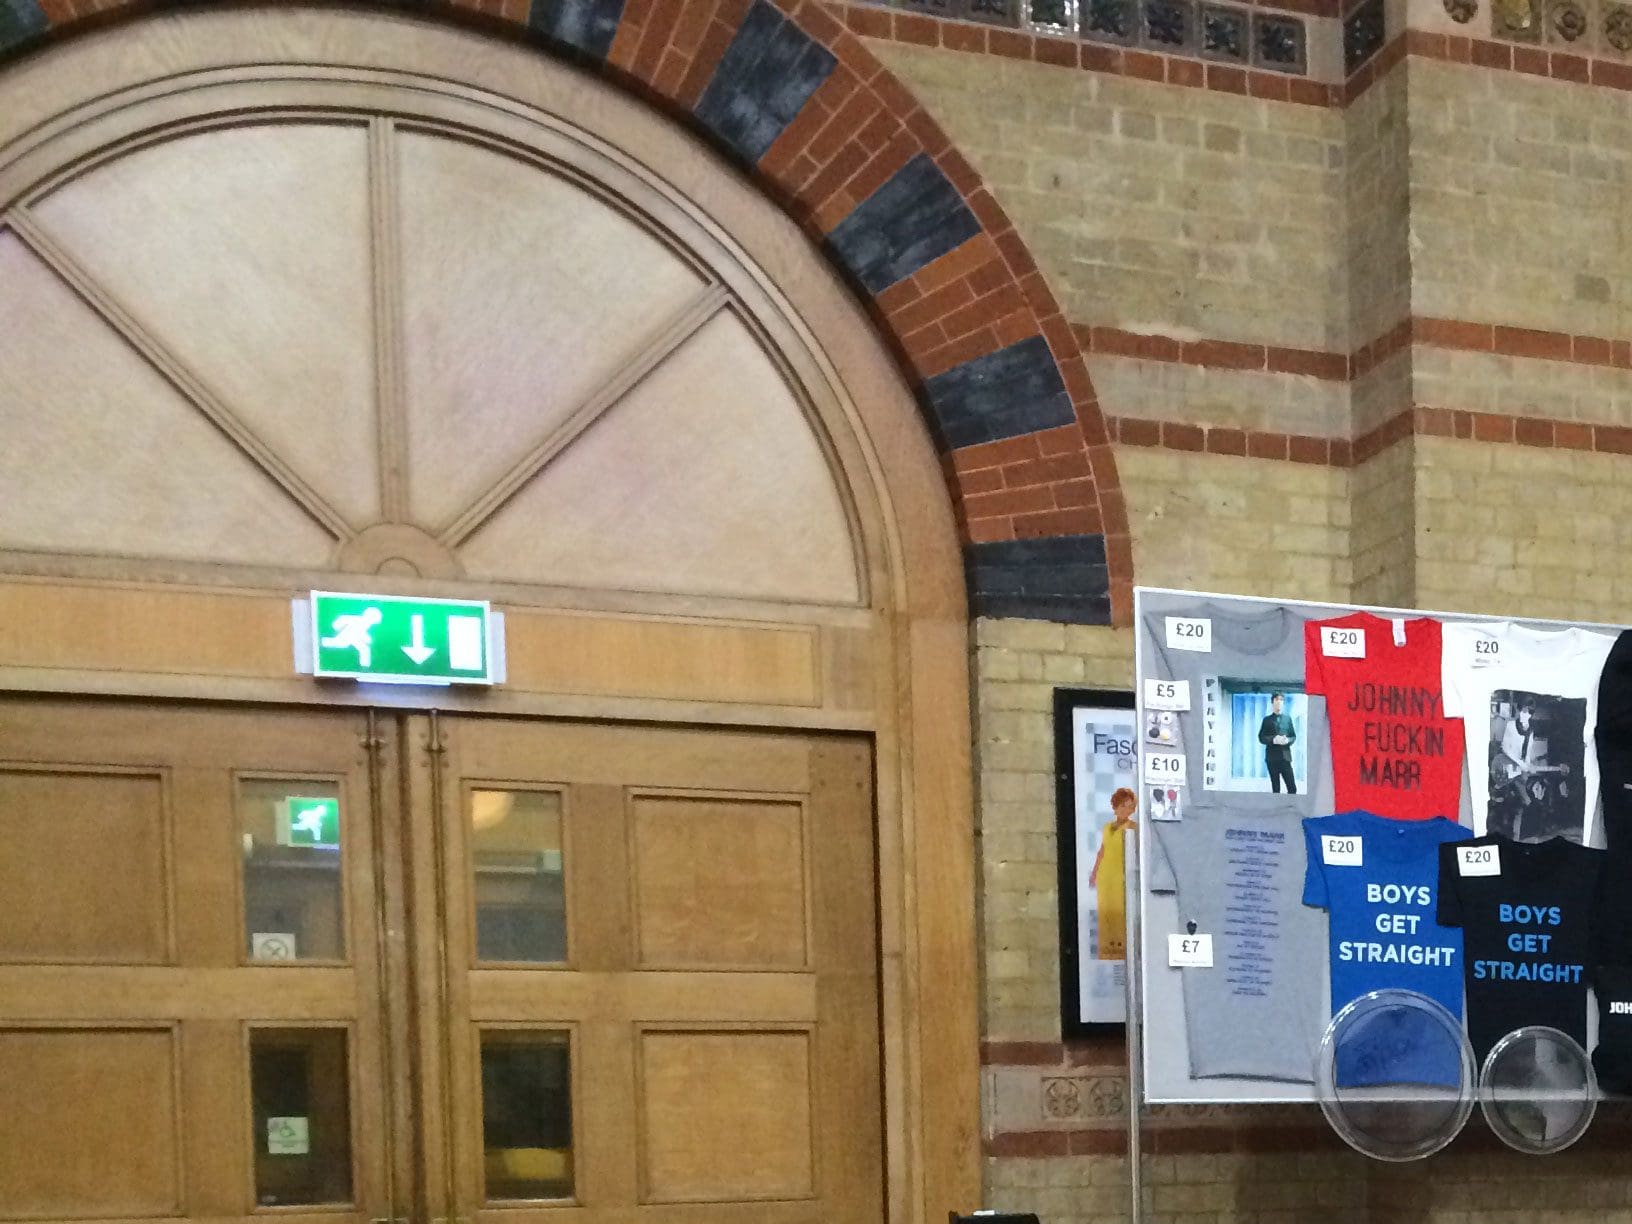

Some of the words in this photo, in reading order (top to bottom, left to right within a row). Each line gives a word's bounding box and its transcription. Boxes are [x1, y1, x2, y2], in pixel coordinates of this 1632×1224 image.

[1176, 622, 1204, 638] £20
[1330, 631, 1357, 645] £20
[1476, 640, 1499, 654] £20
[1156, 684, 1175, 698] £5
[1347, 683, 1443, 720] JOHNNY
[1363, 721, 1444, 757] FUCKIN
[1152, 757, 1180, 772] £10
[1359, 755, 1421, 789] MARR
[1328, 840, 1354, 854] £20
[1465, 850, 1491, 863] £20
[1367, 883, 1431, 906] BOYS
[1375, 914, 1421, 935] GET
[1499, 904, 1561, 926] BOYS
[1182, 939, 1200, 953] £7
[1339, 941, 1455, 967] STRAIGHT
[1507, 934, 1552, 954] GET
[1474, 960, 1583, 984] STRAIGHT
